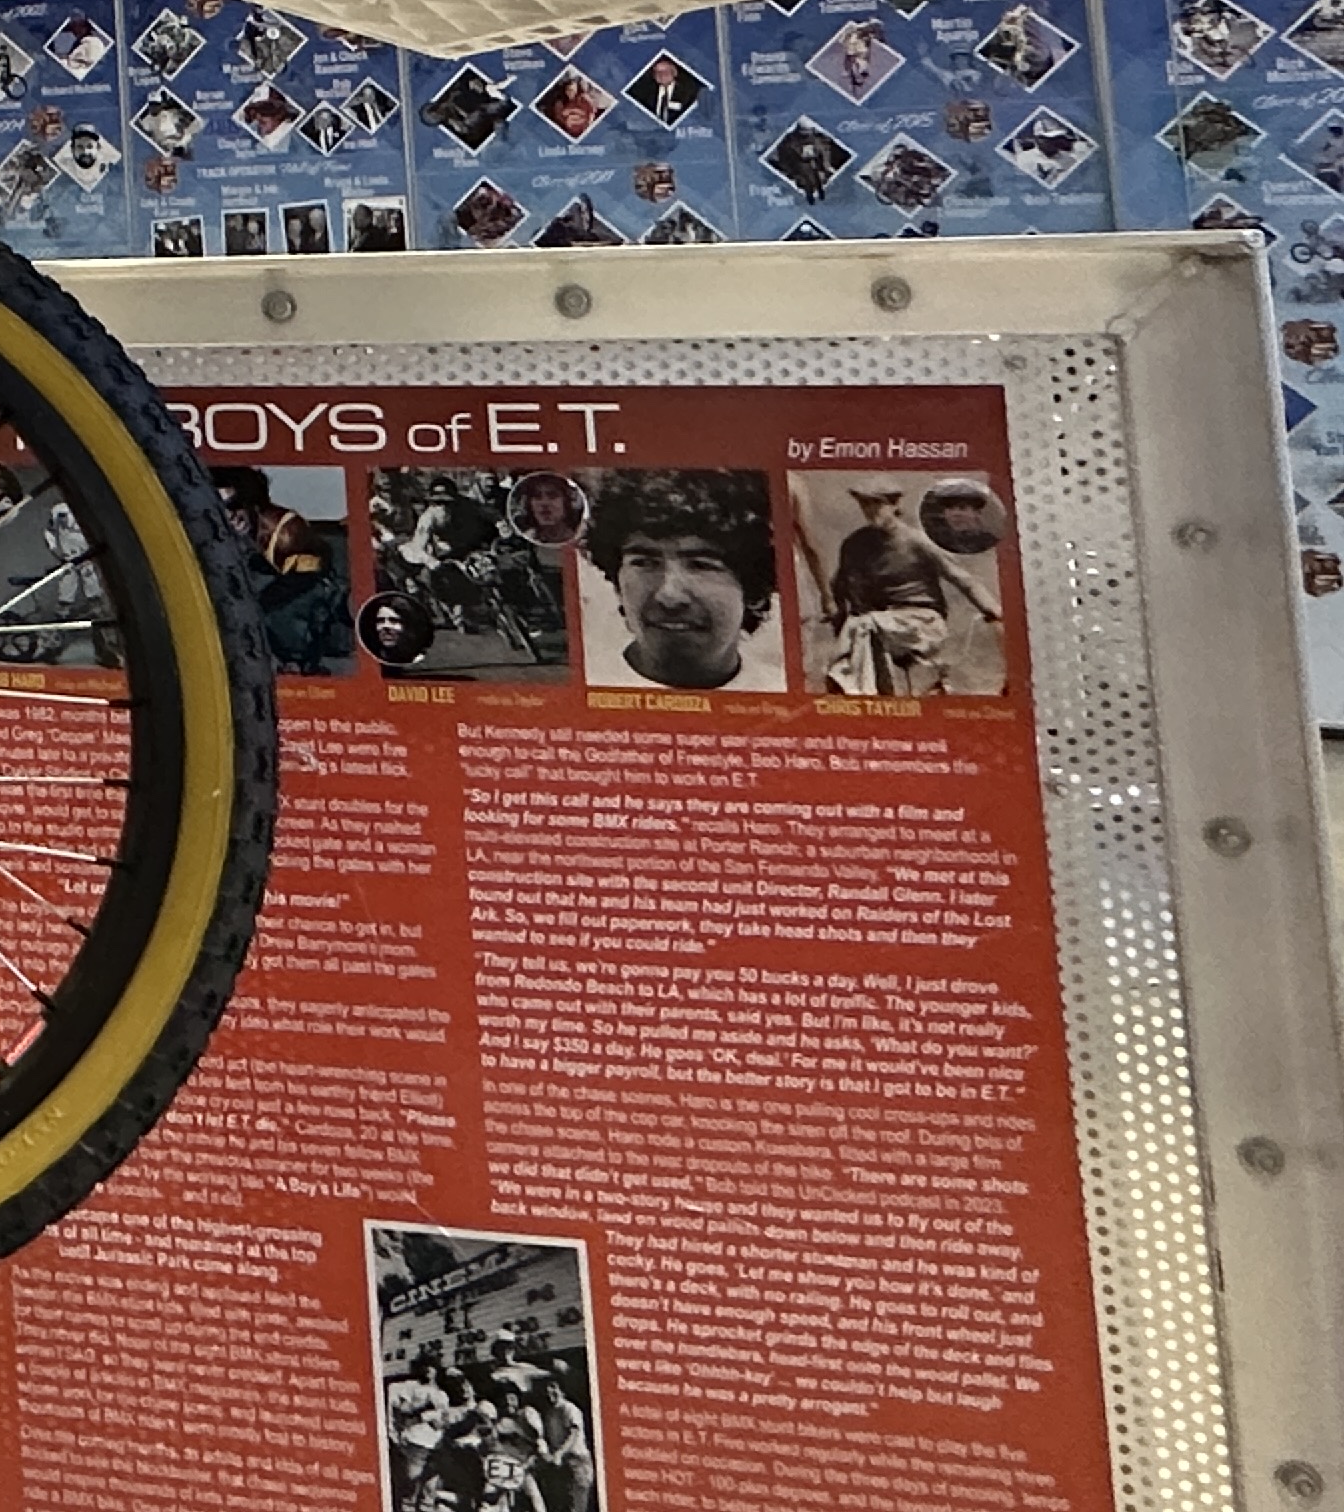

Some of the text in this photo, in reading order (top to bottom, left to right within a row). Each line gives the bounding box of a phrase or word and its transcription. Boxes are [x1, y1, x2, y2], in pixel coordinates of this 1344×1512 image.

[407, 412, 473, 453] of
[487, 402, 627, 453] E.T.
[787, 437, 968, 461] by Emon Hassan
[388, 686, 456, 705] DAVID LEE
